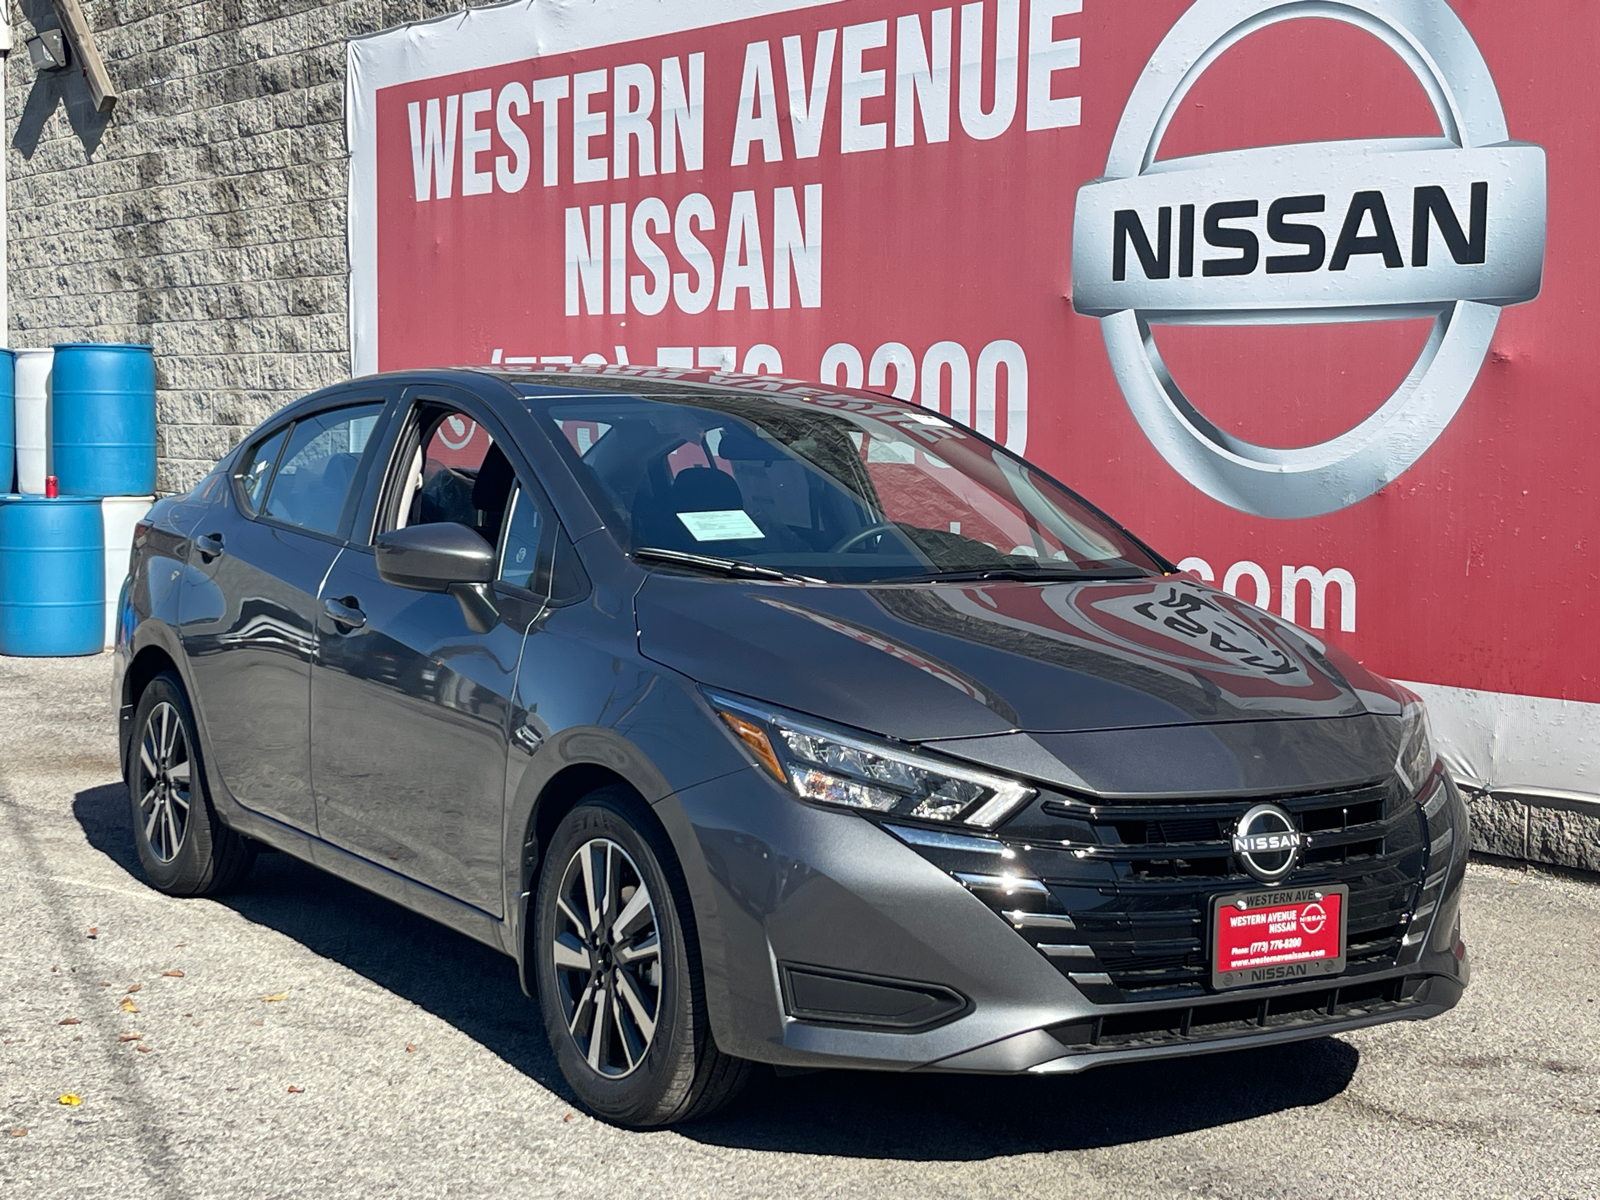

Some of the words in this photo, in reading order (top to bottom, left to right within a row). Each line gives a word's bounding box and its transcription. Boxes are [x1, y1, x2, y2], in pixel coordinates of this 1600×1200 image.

[408, 52, 704, 202] WESTERN
[731, 0, 1083, 166] AVENUE
[1112, 181, 1488, 282] NISSAN
[565, 184, 823, 316] NISSAN
[1235, 835, 1300, 851] NISSAN
[1246, 892, 1293, 906] WESTERN
[1230, 913, 1266, 927] WESTERN
[1267, 910, 1297, 923] AVENUE
[1300, 914, 1326, 922] NISSAN
[1268, 921, 1297, 934] NISSAN
[1250, 941, 1268, 955] (773)
[1269, 937, 1302, 951] 776-8200
[1231, 949, 1325, 967] www.westernavenissan.com
[1251, 964, 1306, 981] NISSAN
